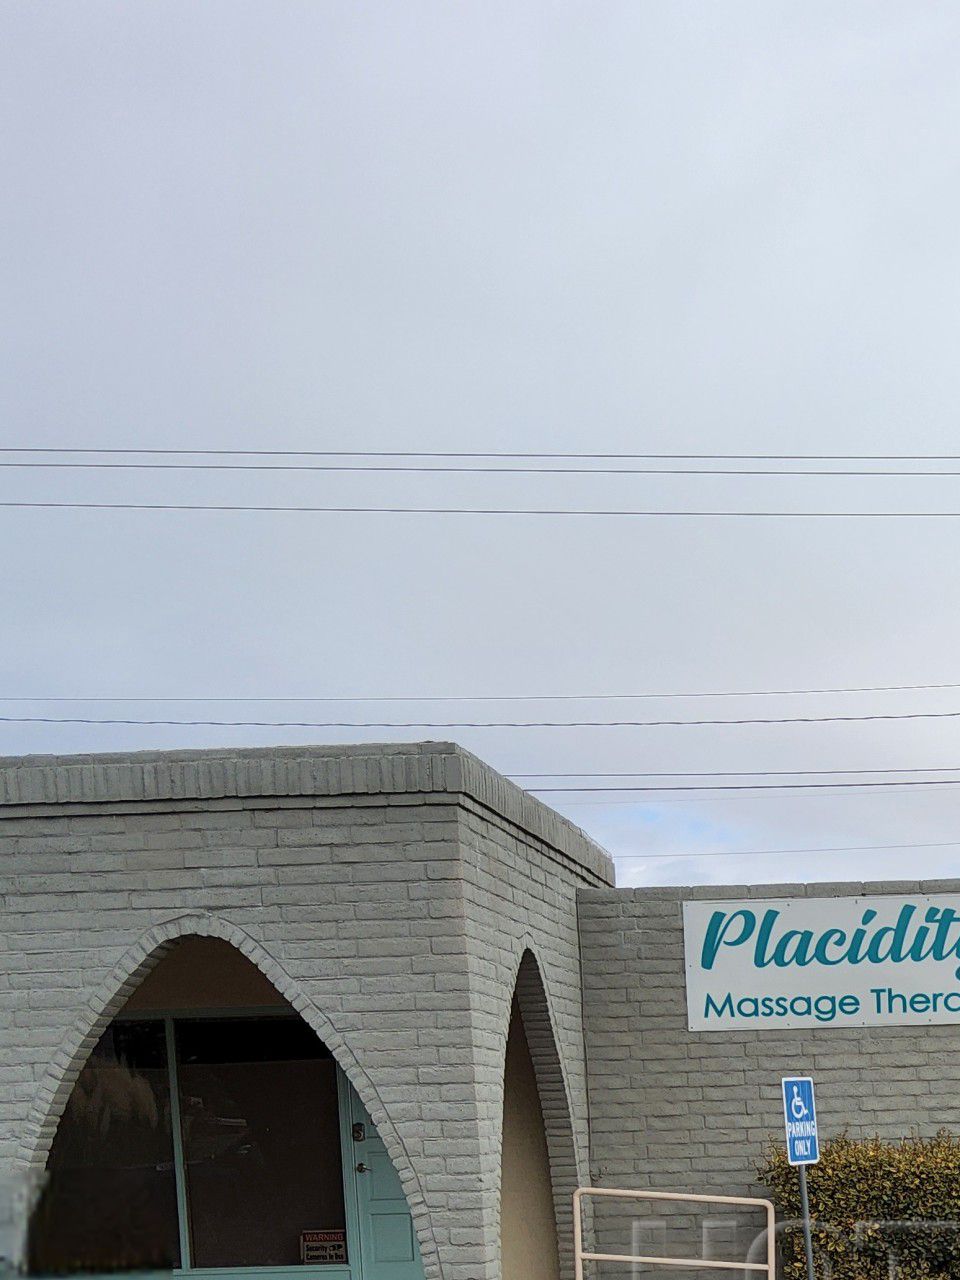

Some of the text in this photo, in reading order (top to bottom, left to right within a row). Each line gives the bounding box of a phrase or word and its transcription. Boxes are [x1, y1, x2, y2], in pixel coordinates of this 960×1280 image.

[704, 992, 860, 1022] Massage
[788, 1121, 816, 1137] PARKING
[794, 1139, 811, 1156] ONLY
[305, 1233, 344, 1241] WARNING
